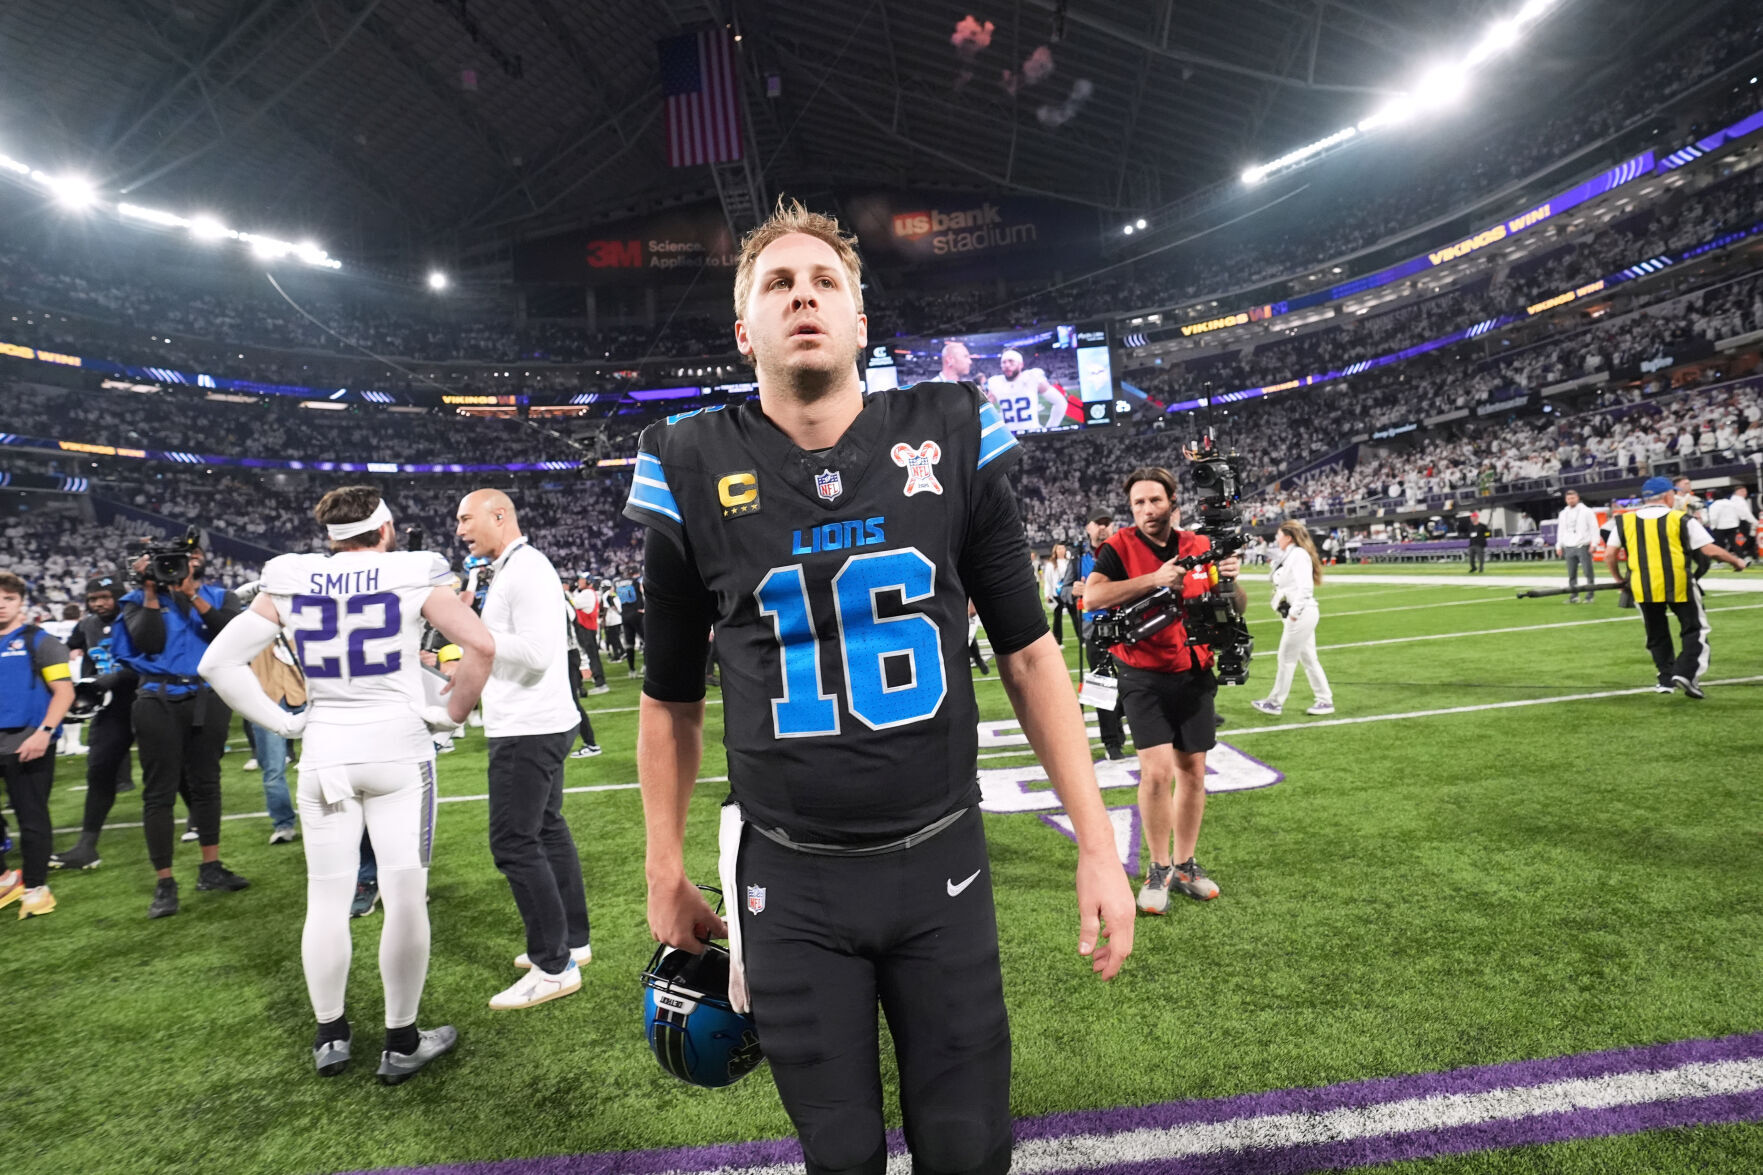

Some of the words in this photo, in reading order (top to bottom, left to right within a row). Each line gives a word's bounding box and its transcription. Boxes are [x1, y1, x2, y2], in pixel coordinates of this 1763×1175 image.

[933, 223, 1037, 255] stadium
[1429, 224, 1507, 265] VIKINGS
[1508, 203, 1551, 233] WIN!
[586, 240, 643, 268] 3M
[649, 255, 701, 270] Applied
[705, 255, 719, 267] to
[1180, 312, 1249, 337] VIKINGS
[442, 395, 498, 405] VIKINGS
[1000, 396, 1032, 424] 22
[911, 465, 930, 478] NFL
[717, 473, 758, 508] C
[820, 483, 838, 496] NFL
[792, 516, 885, 556] LIONS
[310, 568, 379, 595] SMITH
[291, 592, 402, 679] 22
[753, 546, 948, 740] 16
